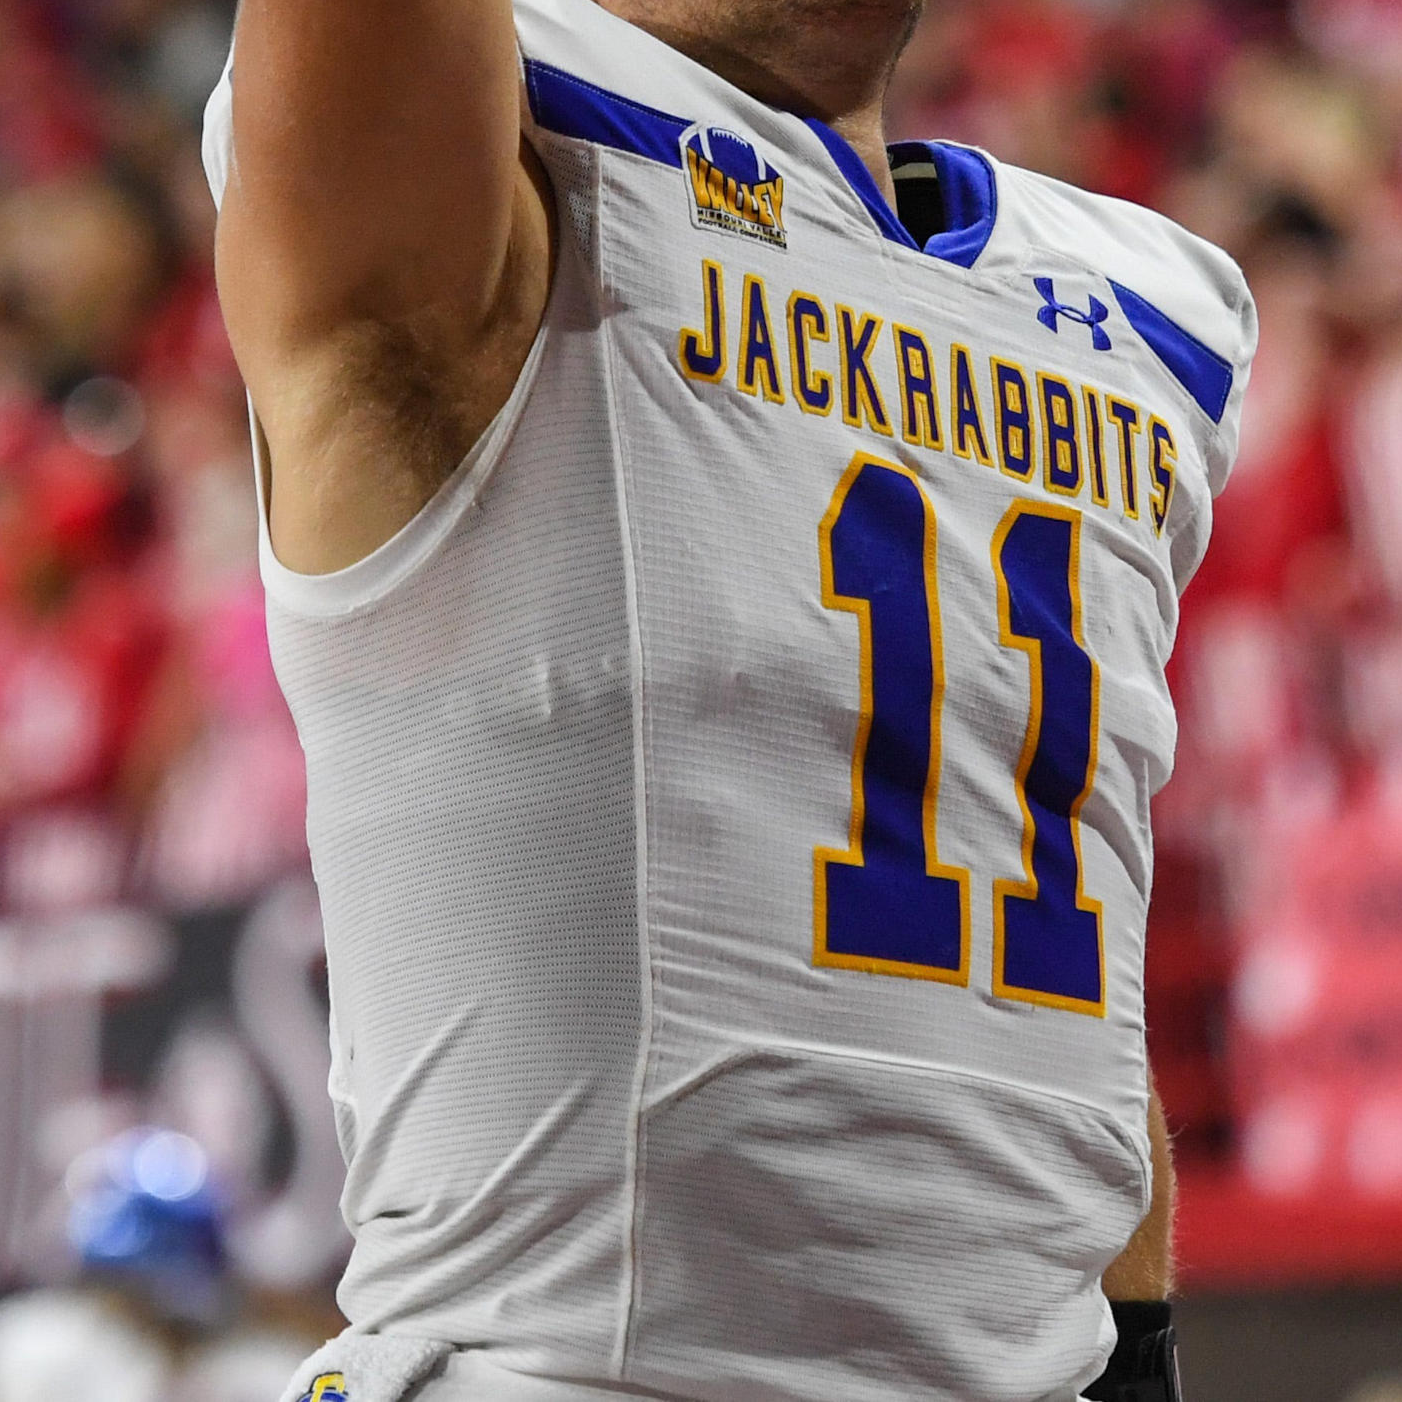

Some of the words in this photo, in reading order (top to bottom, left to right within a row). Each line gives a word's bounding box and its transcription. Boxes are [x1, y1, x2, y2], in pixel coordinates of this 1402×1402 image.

[686, 147, 785, 230] VALLEY
[697, 209, 747, 227] MISSOURI
[750, 223, 786, 239] VALLEY
[697, 218, 738, 234] FOOTBALL
[739, 229, 788, 250] CONFERENCE
[678, 258, 1178, 539] JACKRABBITS
[811, 450, 1107, 1019] 11
